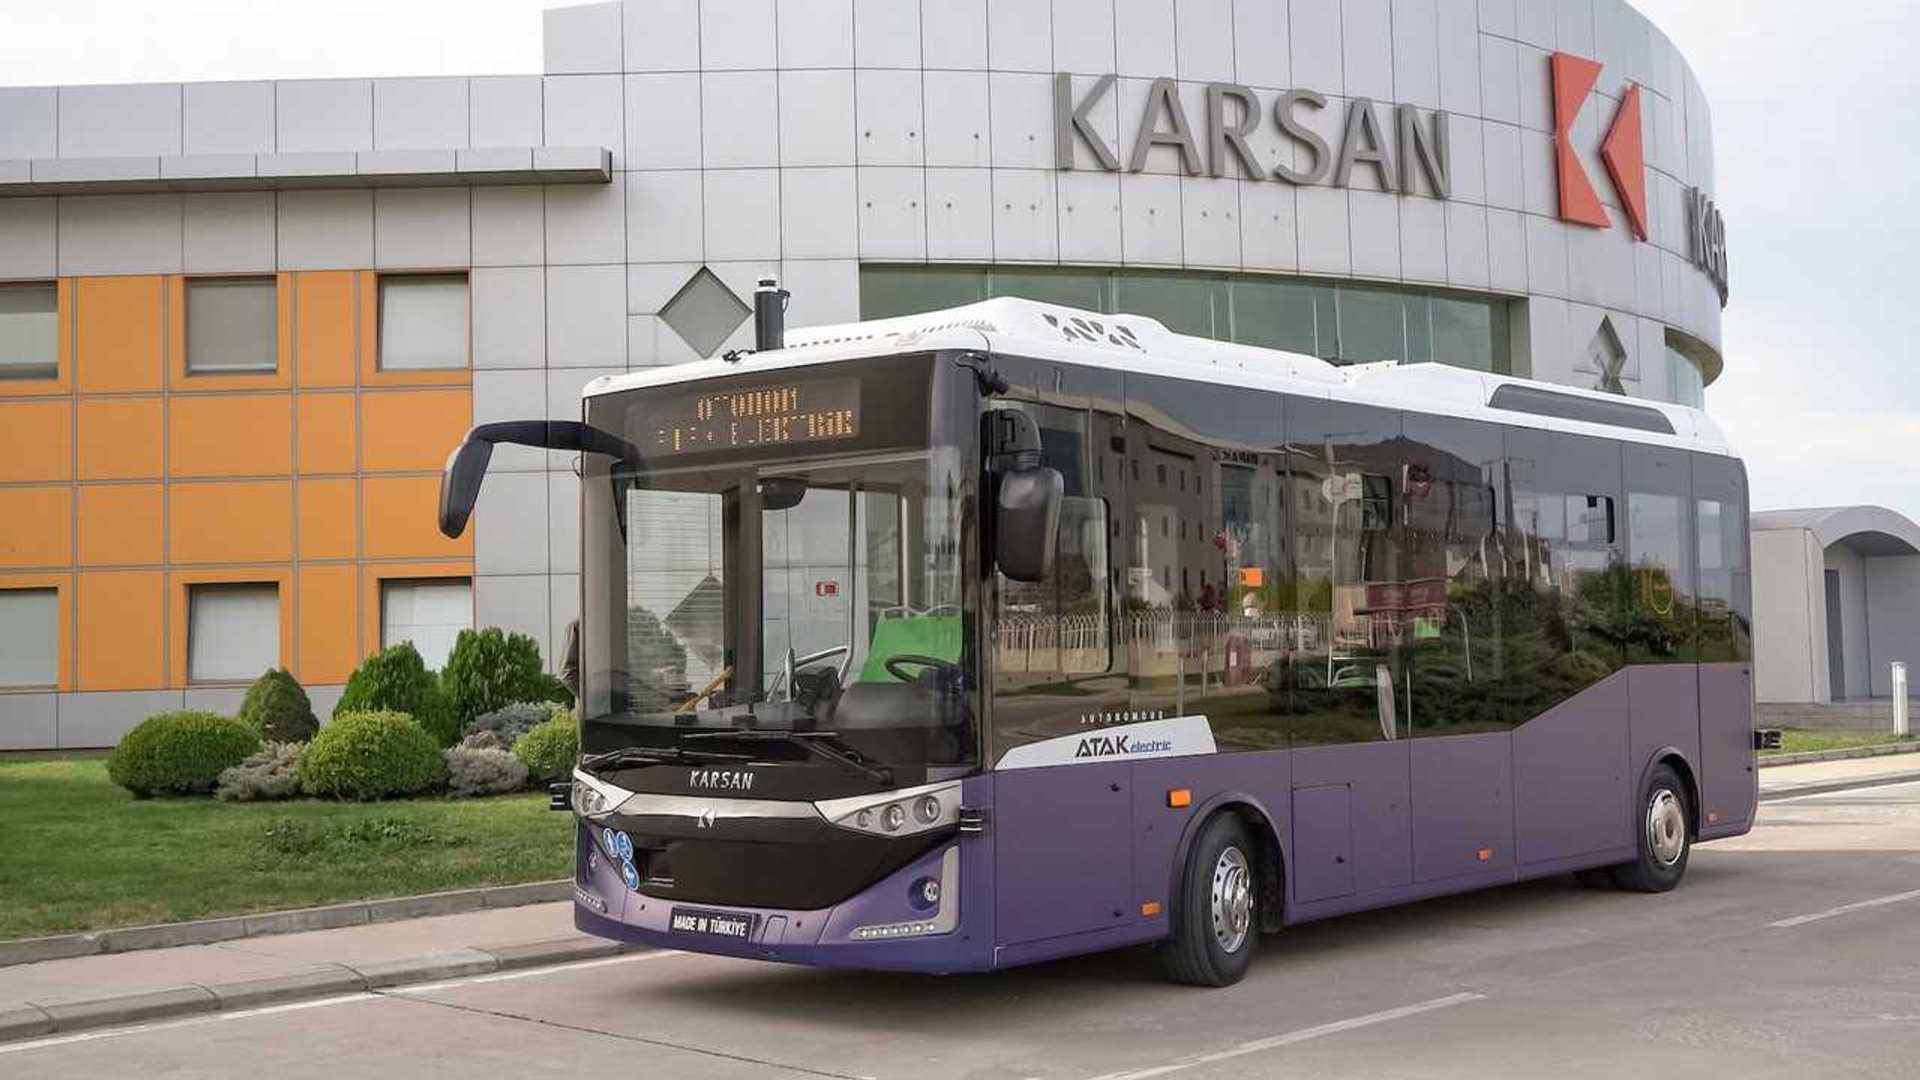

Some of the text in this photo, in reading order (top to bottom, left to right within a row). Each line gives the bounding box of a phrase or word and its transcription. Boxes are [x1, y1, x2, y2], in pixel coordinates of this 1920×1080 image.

[1055, 72, 1452, 200] KARSAN
[1075, 735, 1172, 757] ATAK electric
[689, 770, 754, 790] KARSAN
[673, 914, 697, 932] MADE
[697, 917, 708, 932] IN
